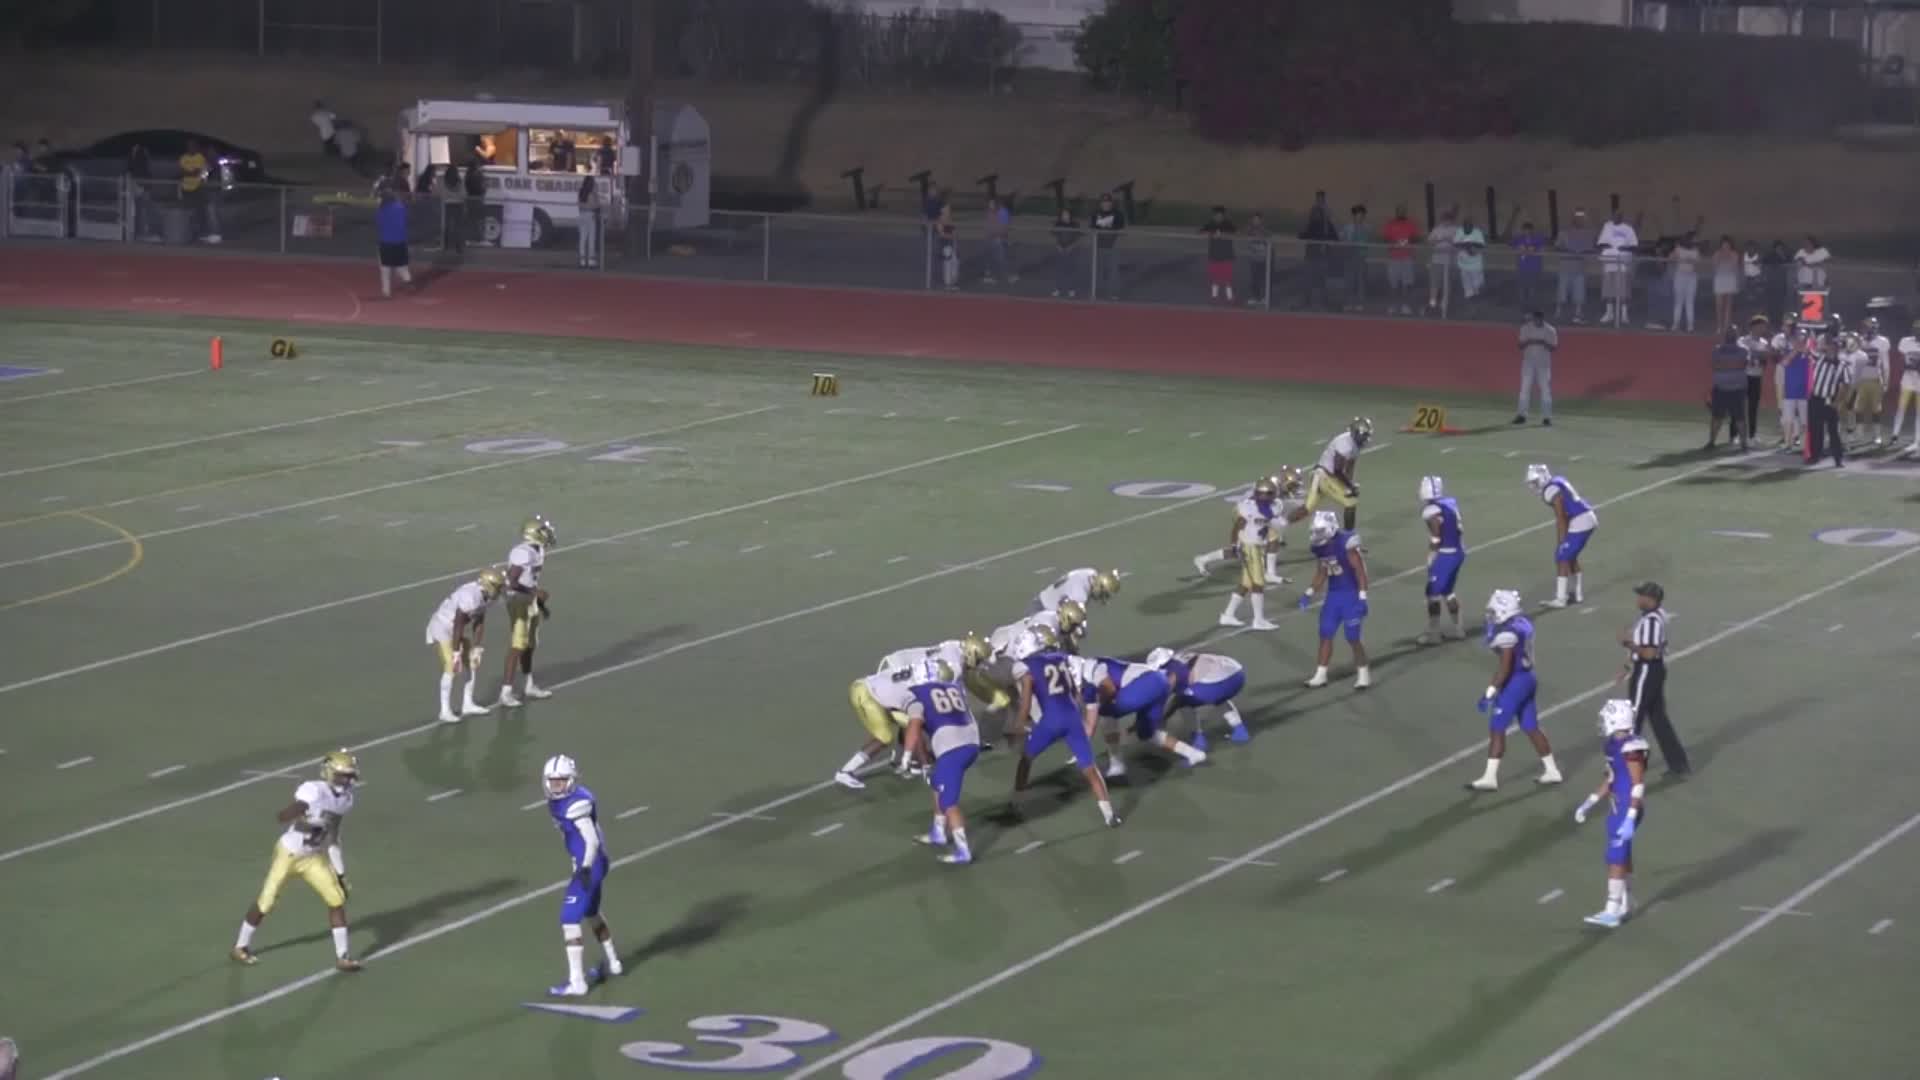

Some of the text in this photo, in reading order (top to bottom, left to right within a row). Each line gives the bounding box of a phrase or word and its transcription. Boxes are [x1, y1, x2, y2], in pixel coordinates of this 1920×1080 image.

[1803, 293, 1825, 321] 2
[812, 376, 833, 397] 10
[1415, 407, 1440, 429] 20
[1043, 660, 1073, 695] 21
[930, 686, 967, 715] 66
